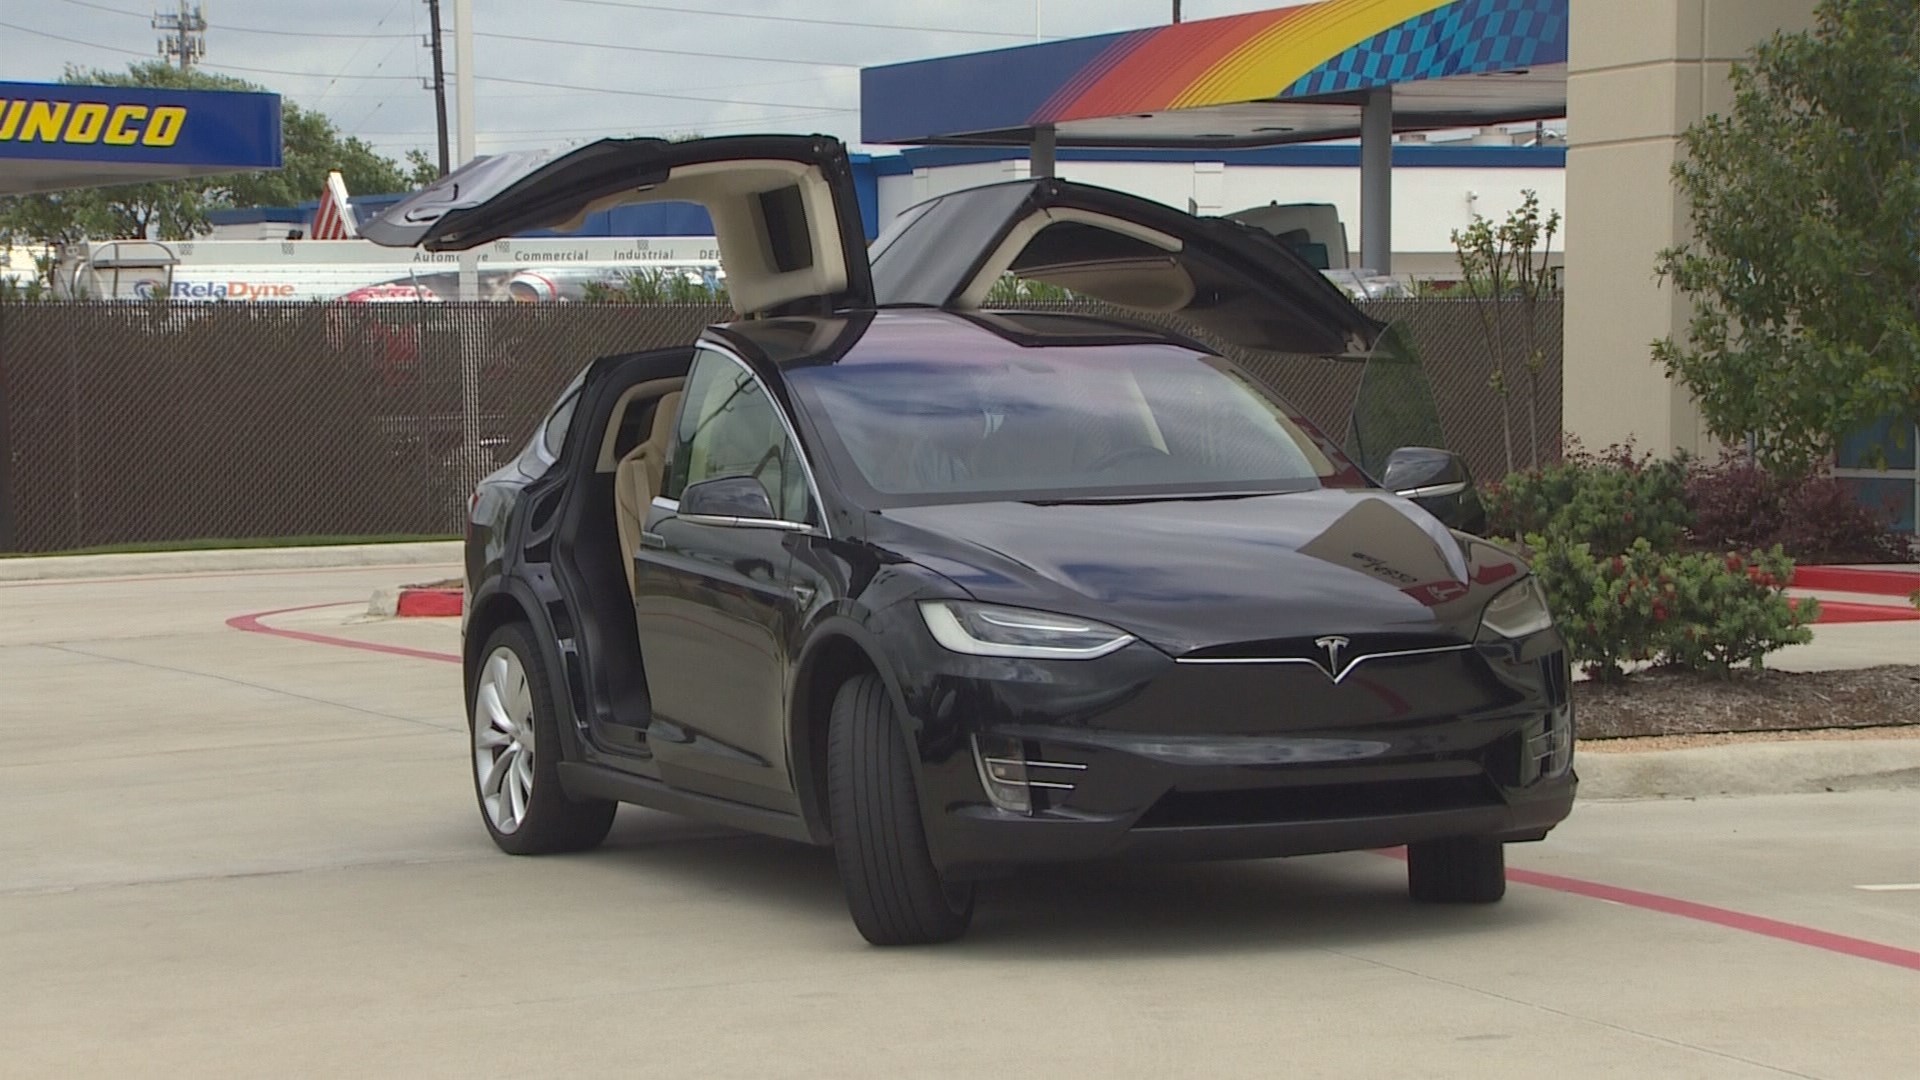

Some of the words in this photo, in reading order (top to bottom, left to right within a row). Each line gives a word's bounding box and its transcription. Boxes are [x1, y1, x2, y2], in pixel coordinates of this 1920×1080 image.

[413, 252, 489, 262] Automve
[515, 250, 589, 262] Commercial
[614, 249, 674, 260] Industrial
[172, 281, 295, 300] RelaDyne
